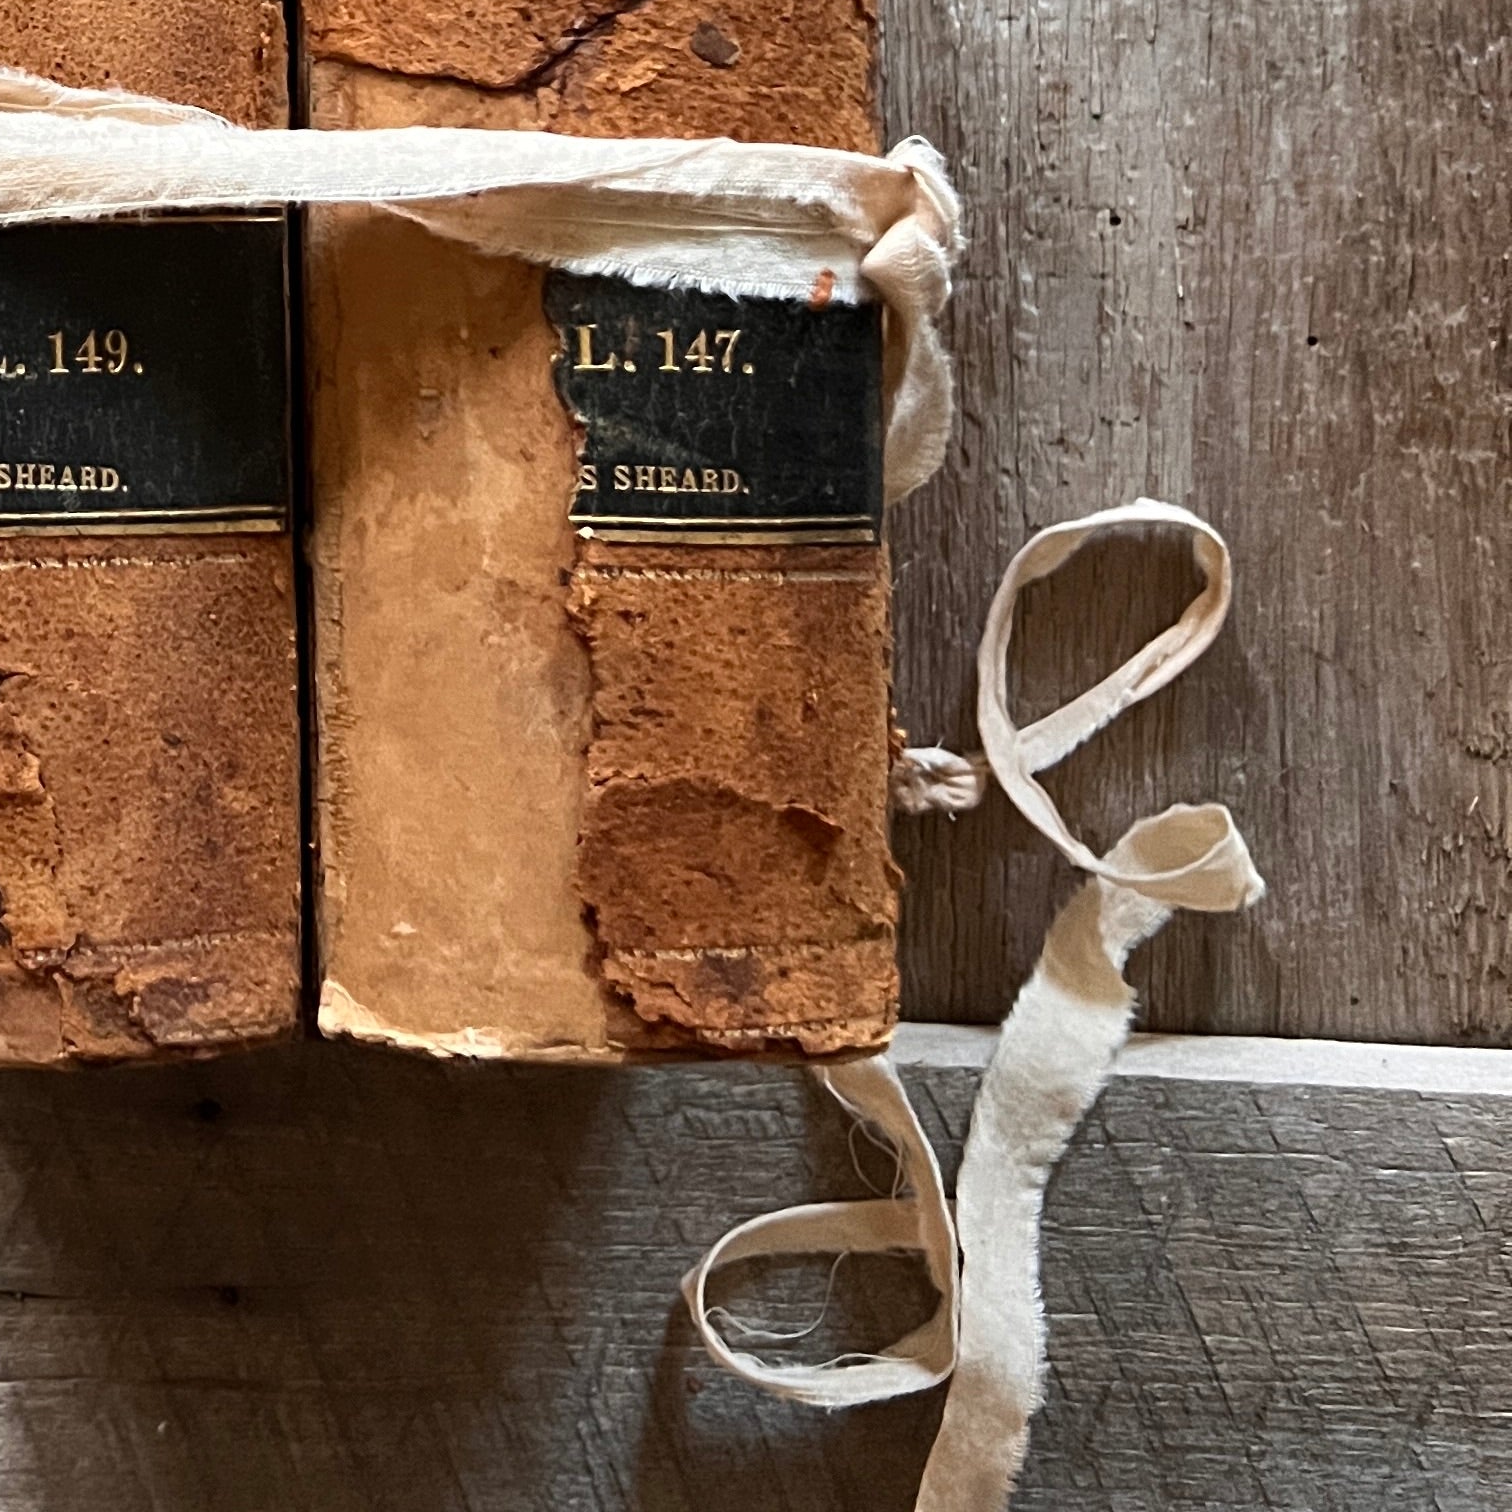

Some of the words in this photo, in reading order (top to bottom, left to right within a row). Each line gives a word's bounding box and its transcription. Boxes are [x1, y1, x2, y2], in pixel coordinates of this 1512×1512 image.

[47, 328, 145, 376] 149.
[656, 328, 755, 375] 147.
[613, 464, 751, 496] SHEARD.
